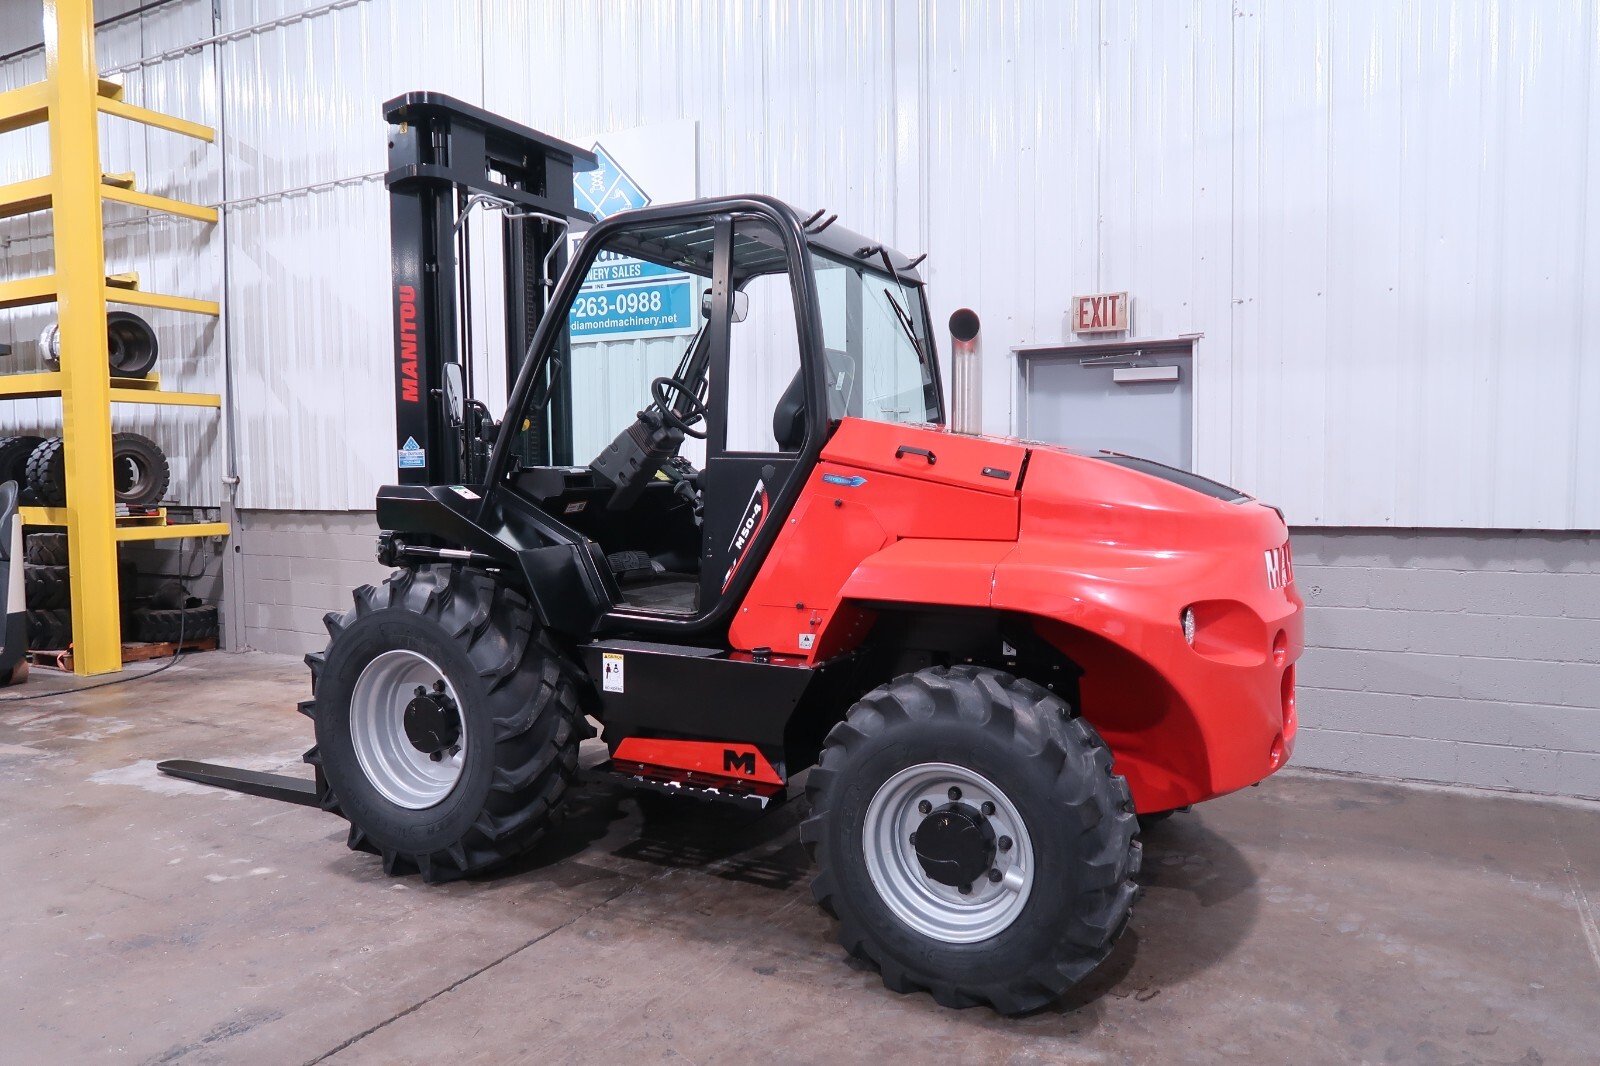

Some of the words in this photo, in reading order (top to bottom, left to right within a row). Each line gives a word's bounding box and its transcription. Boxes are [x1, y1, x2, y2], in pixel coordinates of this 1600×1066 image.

[585, 267, 610, 281] NERY
[612, 264, 641, 279] SALES
[570, 291, 662, 318] -263-0988
[1079, 295, 1120, 329] EXIT
[570, 313, 678, 331] diamondmachinery.net
[399, 285, 419, 402] MANITOU
[723, 749, 756, 775] M
